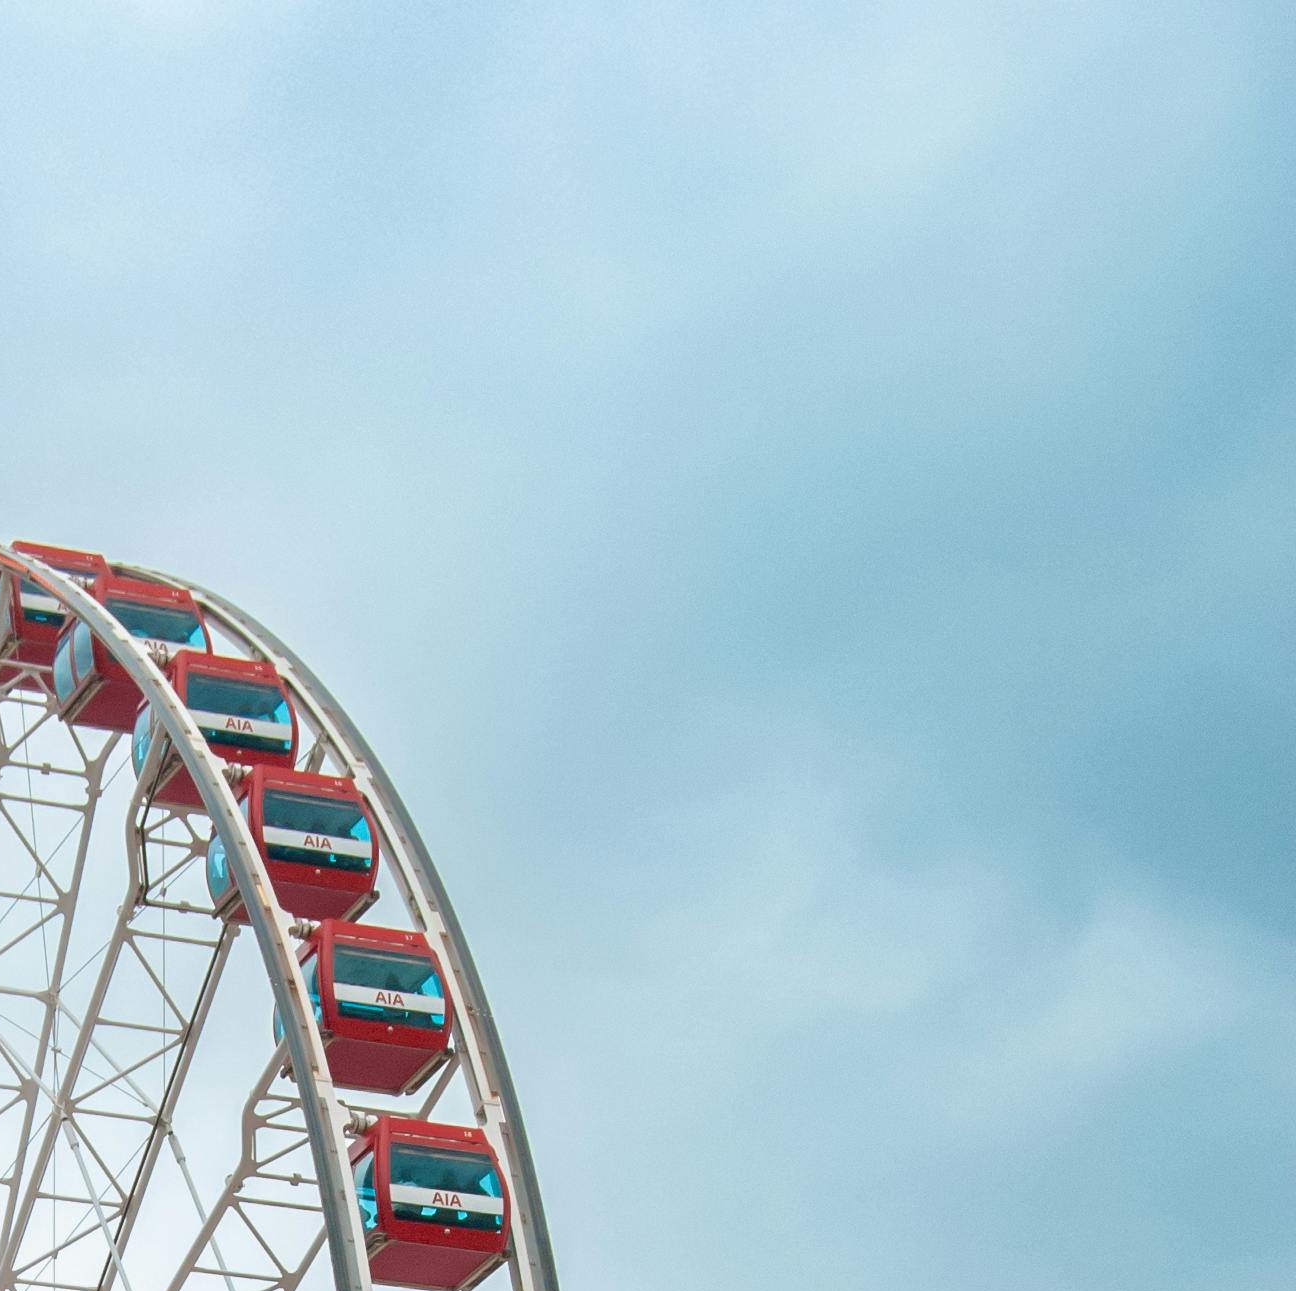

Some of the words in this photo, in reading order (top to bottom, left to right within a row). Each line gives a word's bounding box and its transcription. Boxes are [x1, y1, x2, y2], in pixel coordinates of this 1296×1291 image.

[225, 717, 253, 732] AIA
[303, 836, 332, 850] AIA
[375, 992, 404, 1006] AIA
[432, 1192, 461, 1207] AIA
